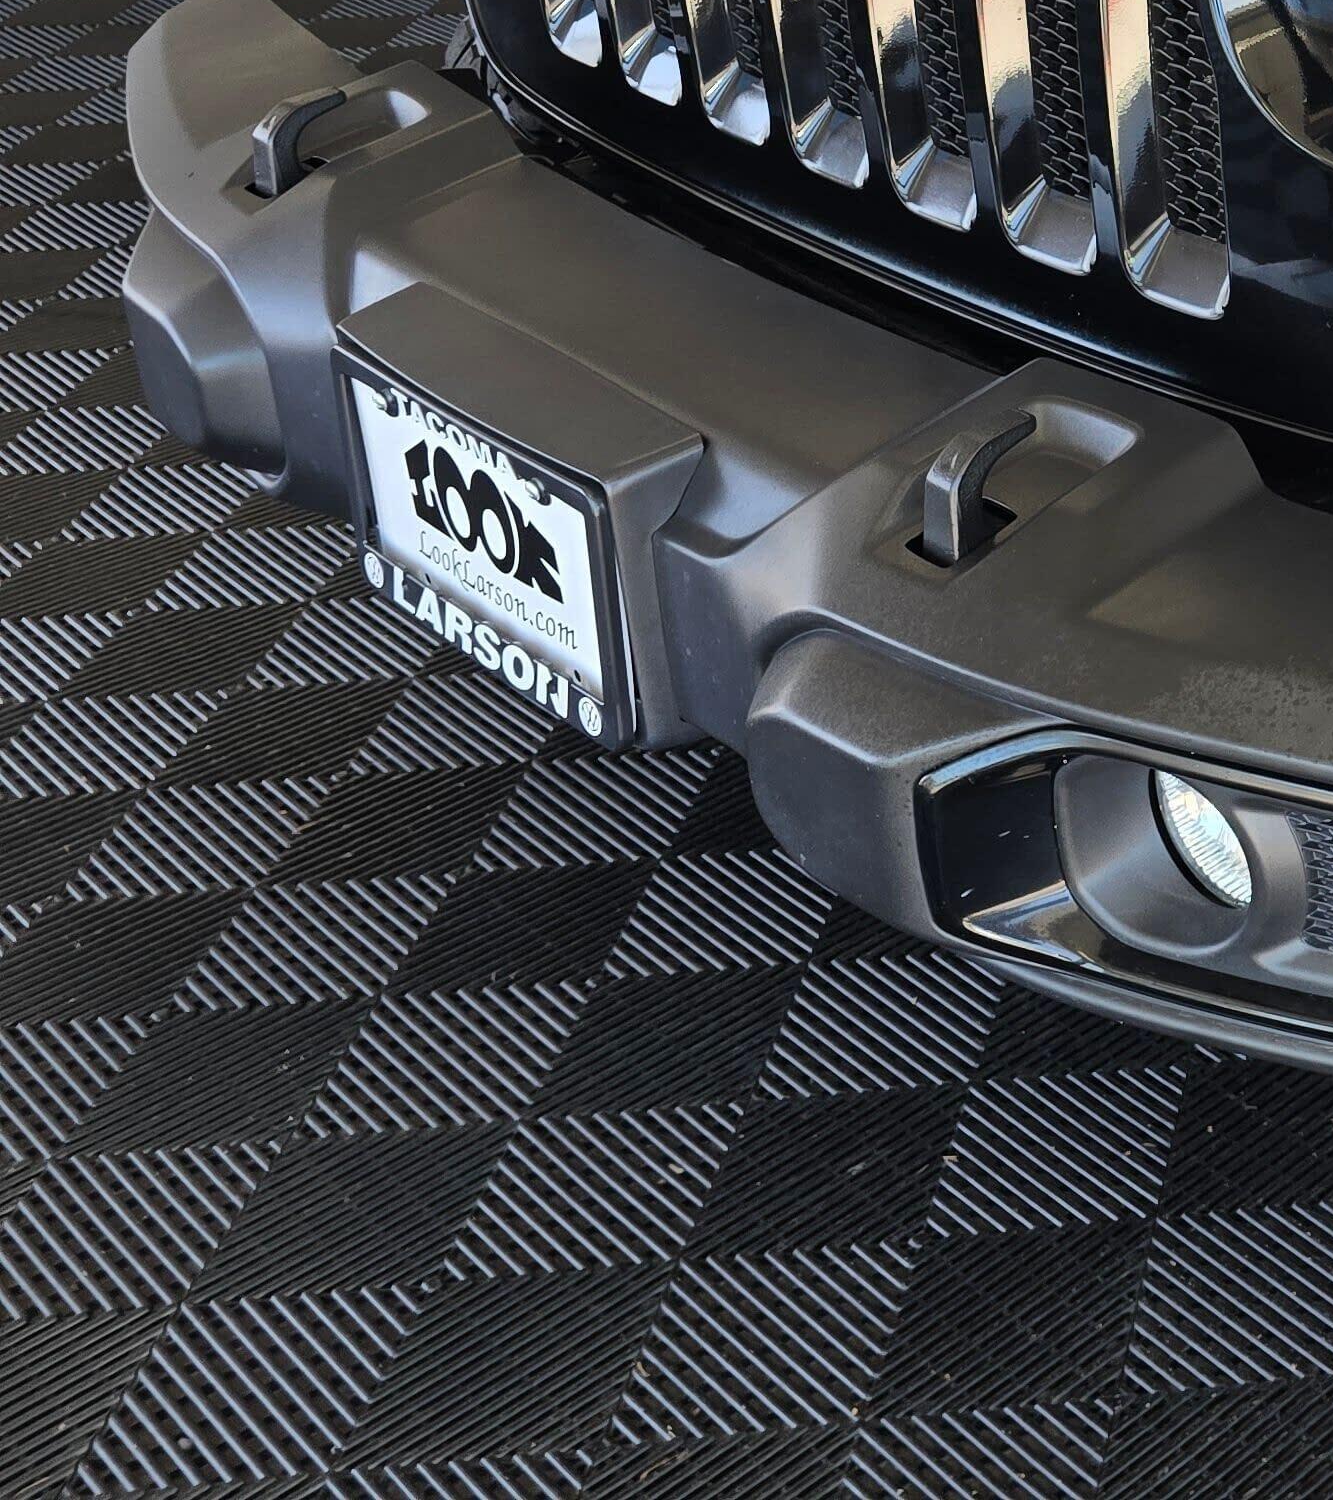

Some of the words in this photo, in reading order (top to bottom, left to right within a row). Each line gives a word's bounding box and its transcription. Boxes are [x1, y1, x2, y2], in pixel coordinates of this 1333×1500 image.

[390, 387, 522, 482] TACOMA
[392, 565, 570, 720] LARSON
[419, 530, 579, 651] LookLarson.com
